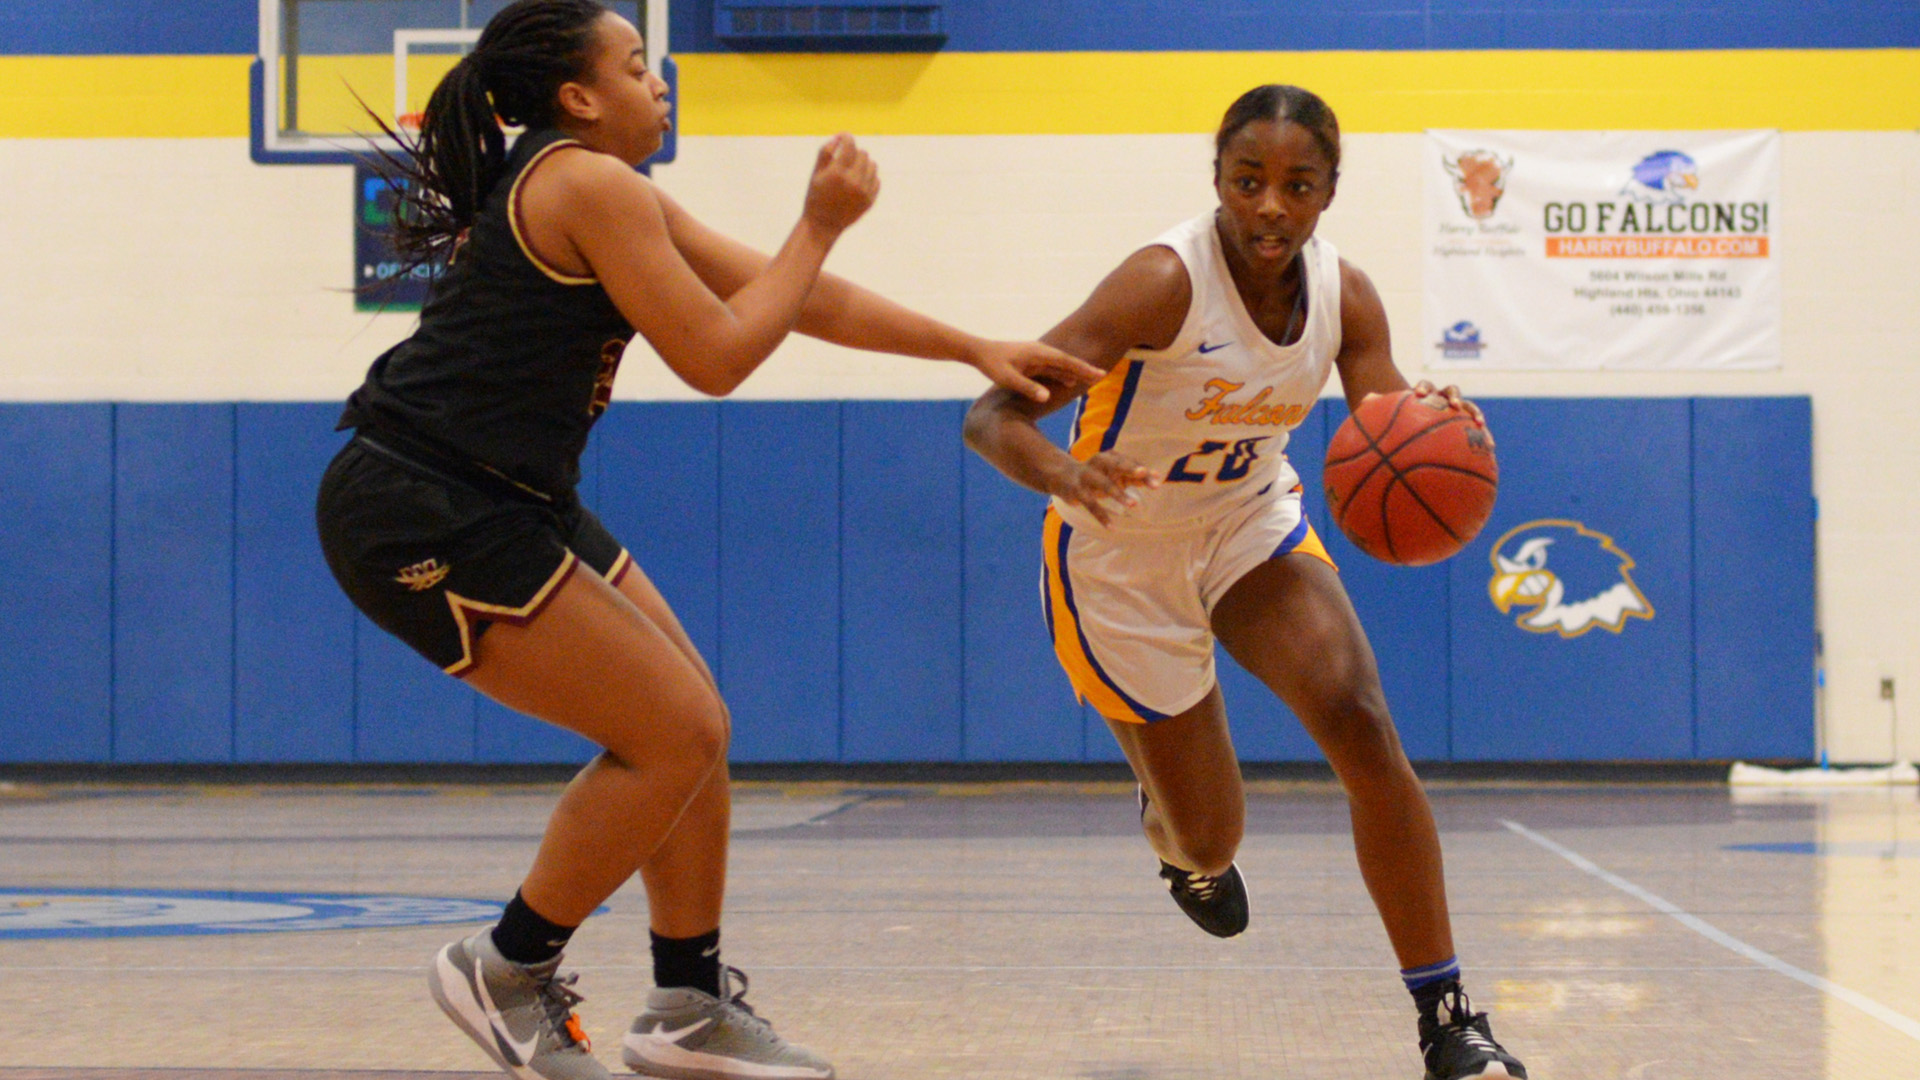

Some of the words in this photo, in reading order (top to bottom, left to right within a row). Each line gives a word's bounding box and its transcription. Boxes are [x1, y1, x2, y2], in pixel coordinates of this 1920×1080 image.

[1545, 202, 1586, 232] GO
[1597, 202, 1768, 232] FALCONS!
[1559, 239, 1759, 255] HARRYBUFFALO.COM
[1624, 270, 1669, 281] Wilson
[1673, 270, 1703, 281] Mills
[1708, 270, 1727, 281] Rd
[1574, 287, 1634, 301] Highland
[1667, 287, 1699, 298] Ohio
[1185, 378, 1311, 425] Falcon
[1164, 436, 1272, 484] 20
